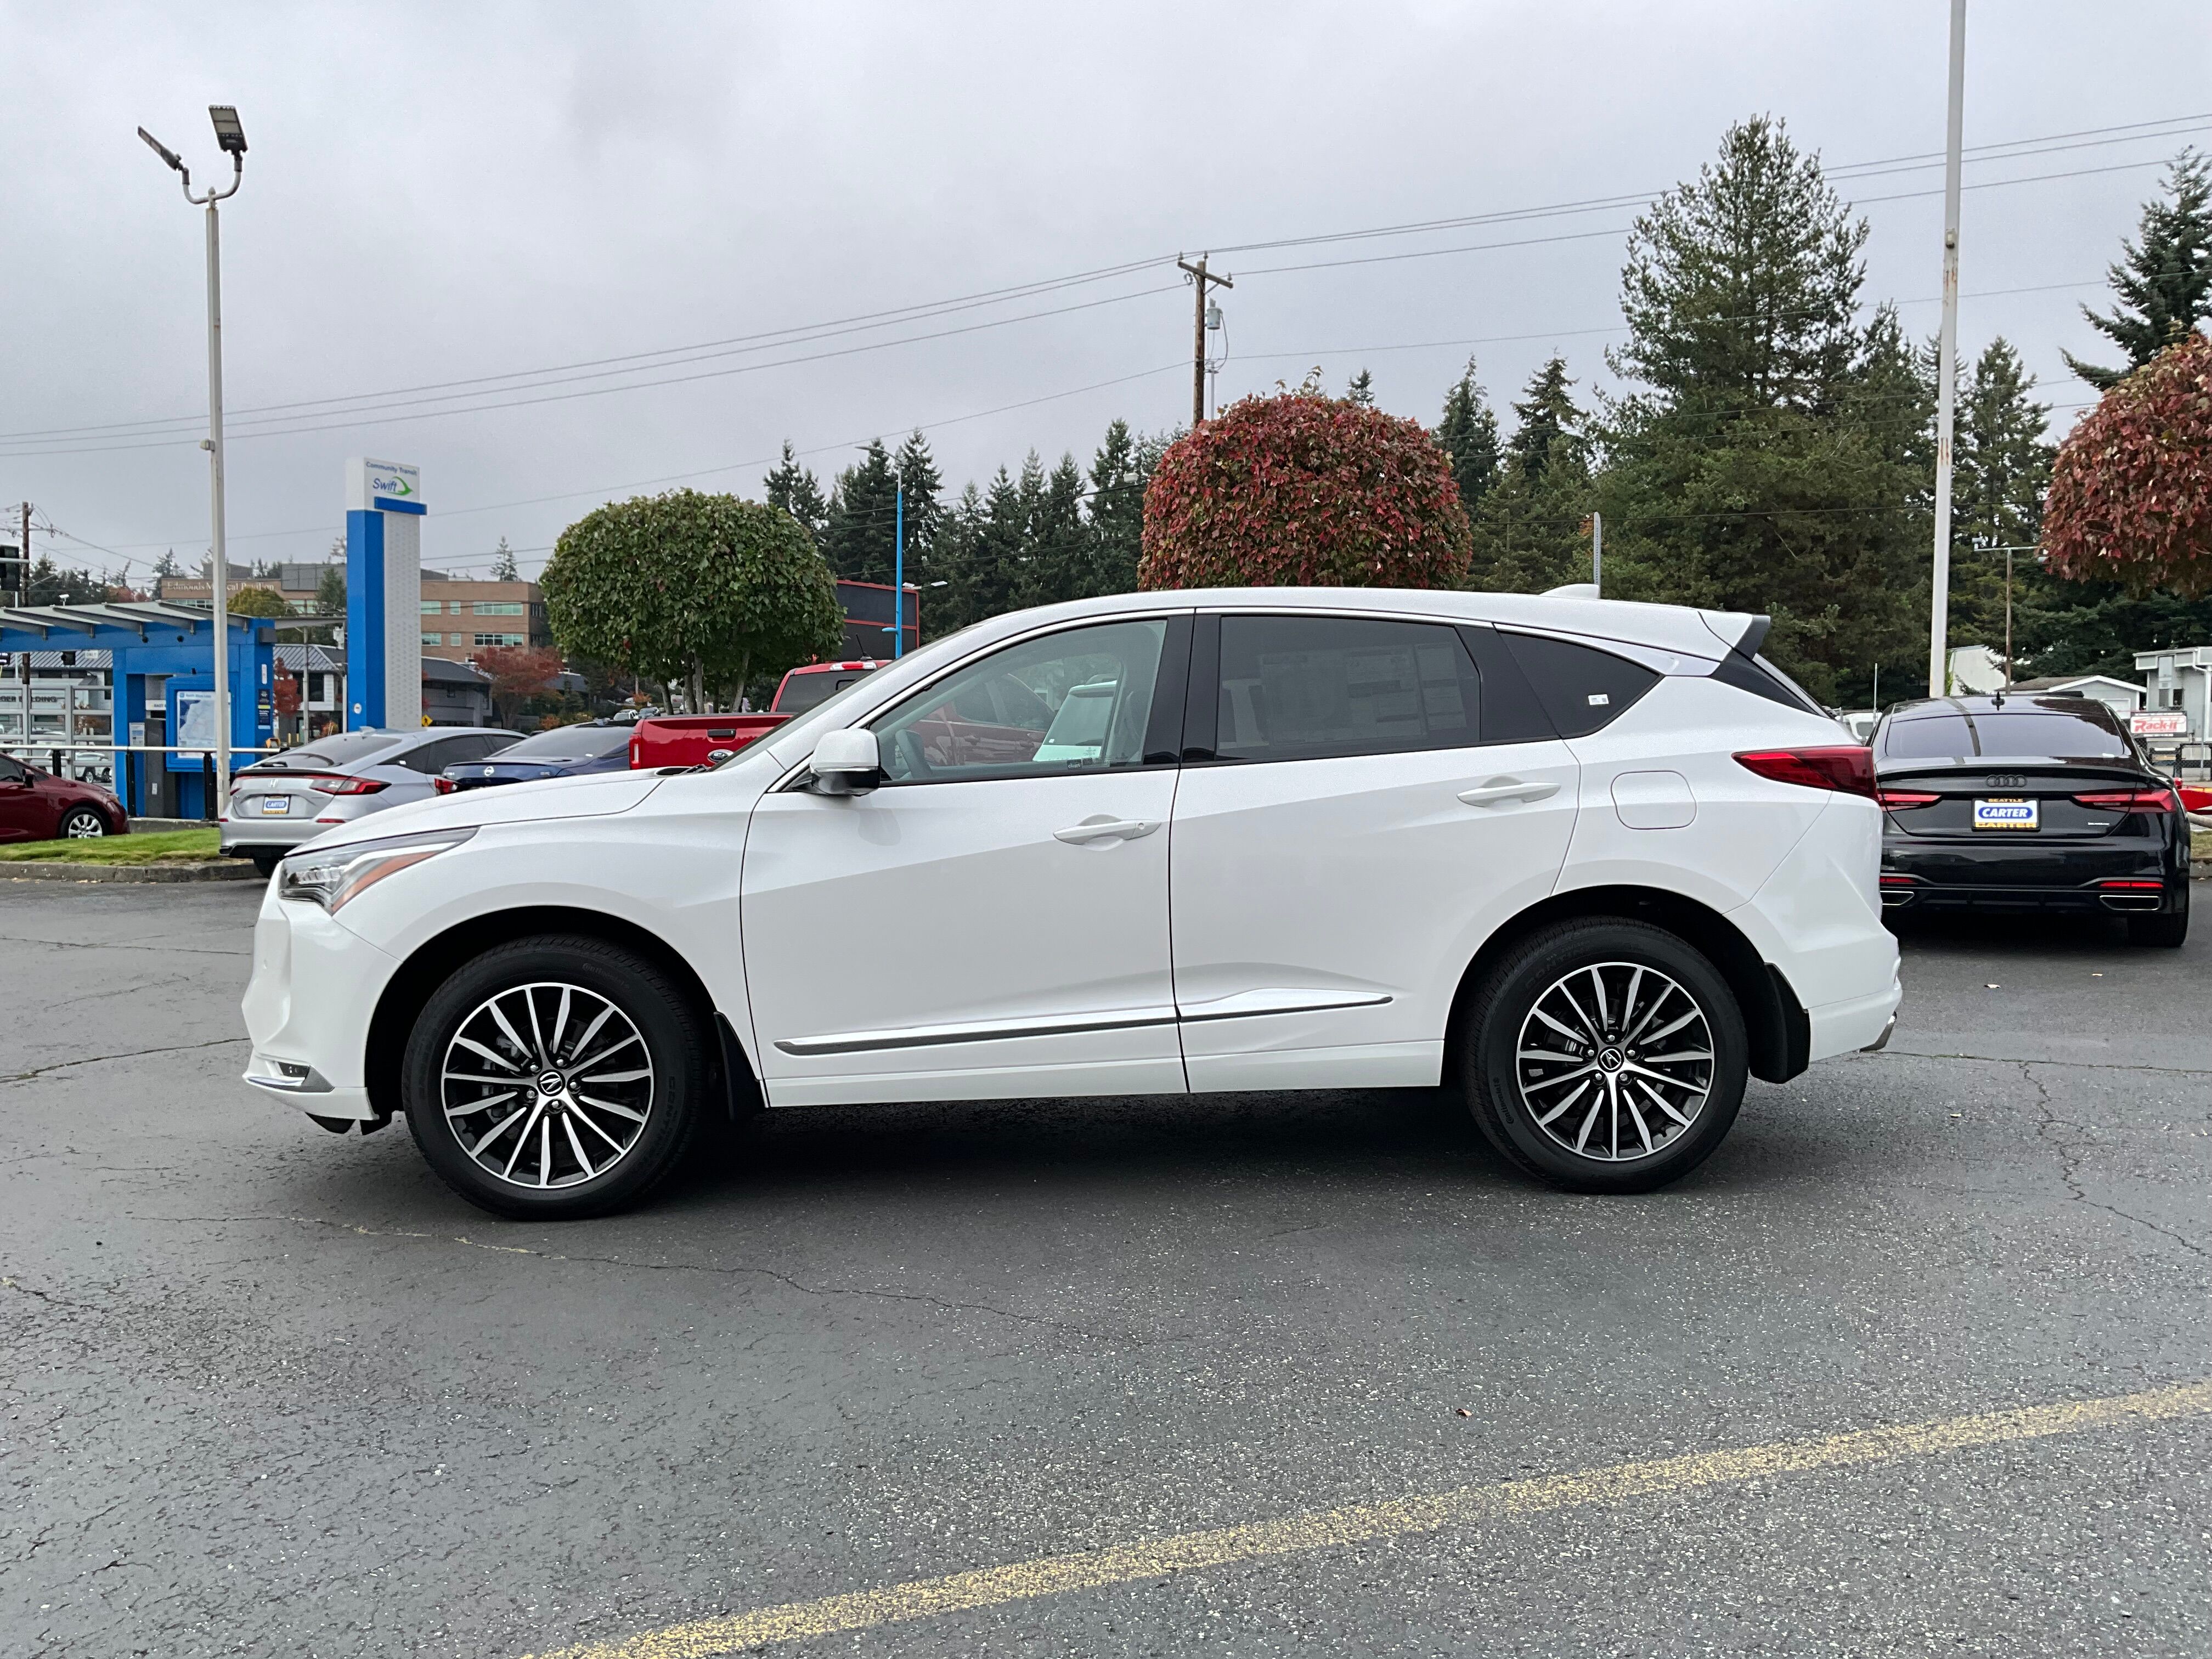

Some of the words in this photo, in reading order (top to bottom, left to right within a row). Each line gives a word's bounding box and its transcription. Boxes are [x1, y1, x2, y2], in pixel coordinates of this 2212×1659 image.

[366, 461, 398, 473] Community
[399, 467, 417, 476] Transit
[373, 478, 397, 492] Swift
[167, 582, 205, 590] Edmonds
[206, 582, 239, 591] Mcal
[1982, 808, 2028, 817] CARTER
